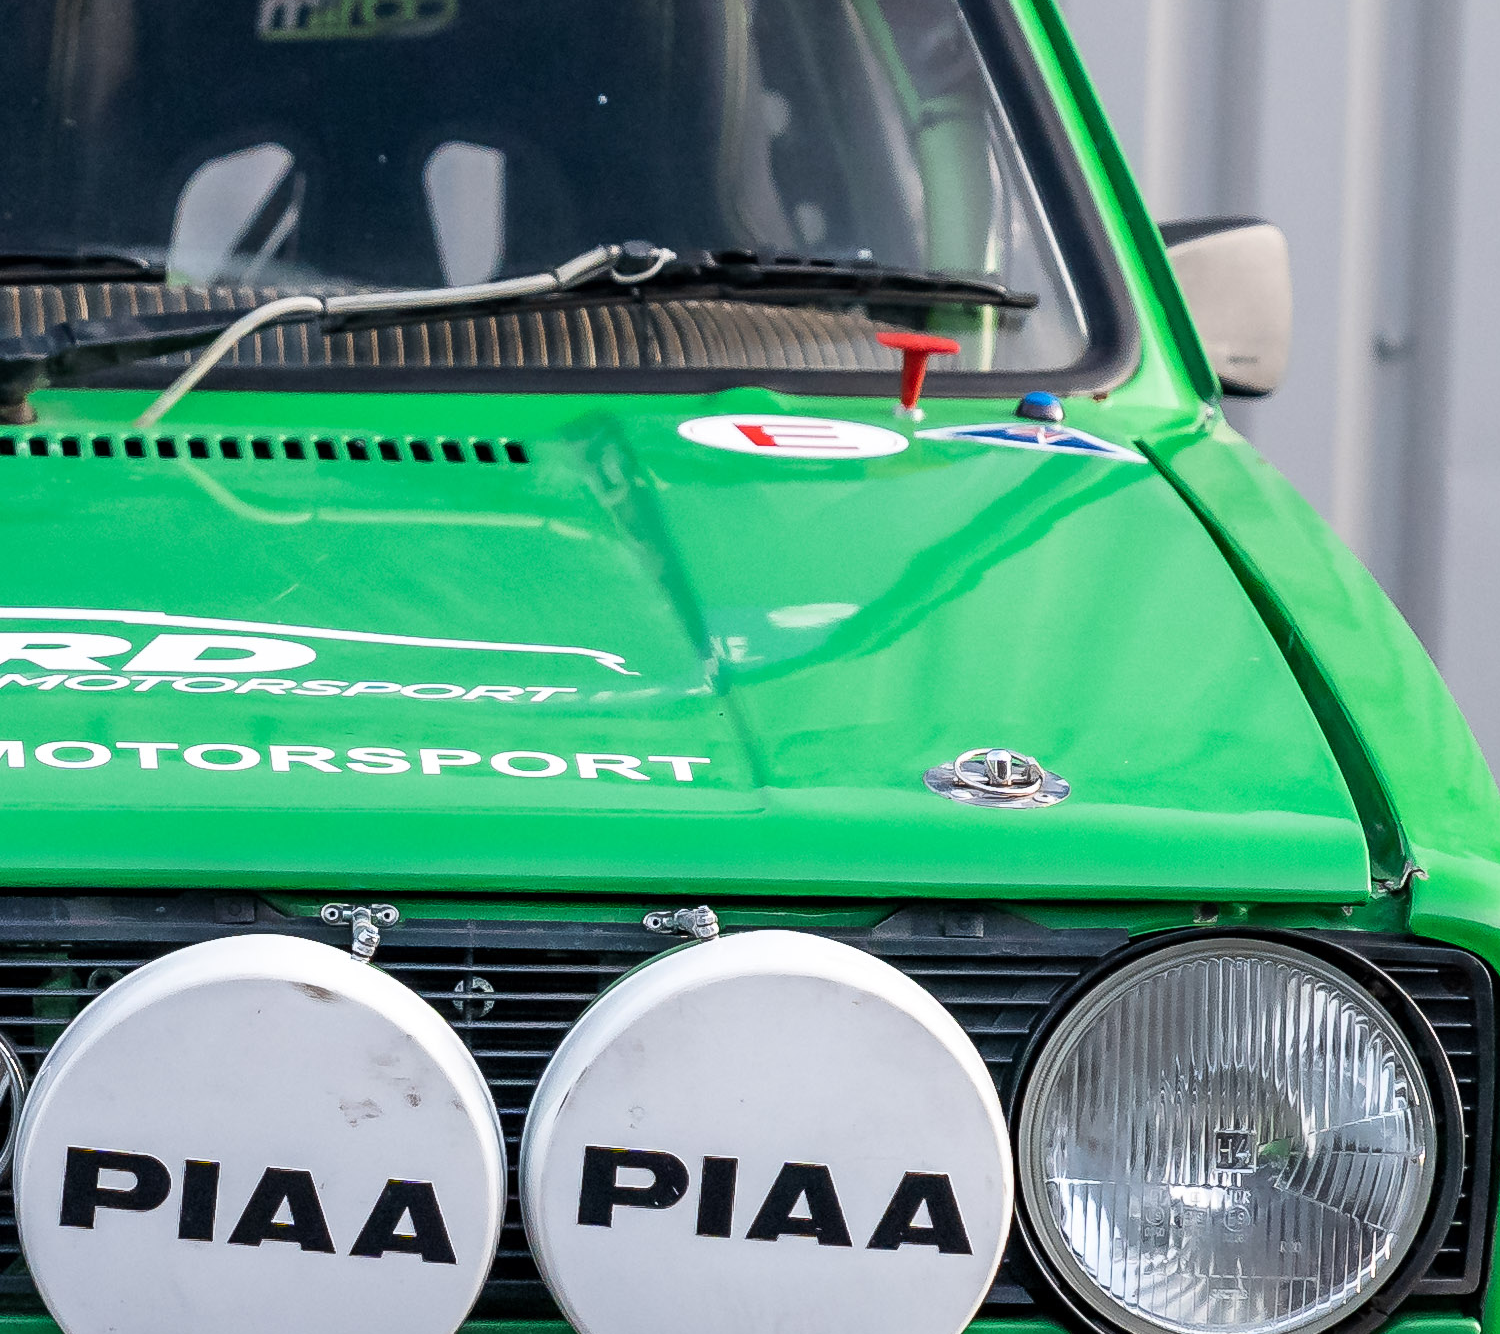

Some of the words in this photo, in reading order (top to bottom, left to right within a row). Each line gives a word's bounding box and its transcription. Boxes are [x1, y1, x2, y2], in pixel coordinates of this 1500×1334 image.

[58, 1146, 458, 1265] PIAA
[576, 1144, 974, 1256] PIAA
[1216, 1138, 1251, 1164] H4
